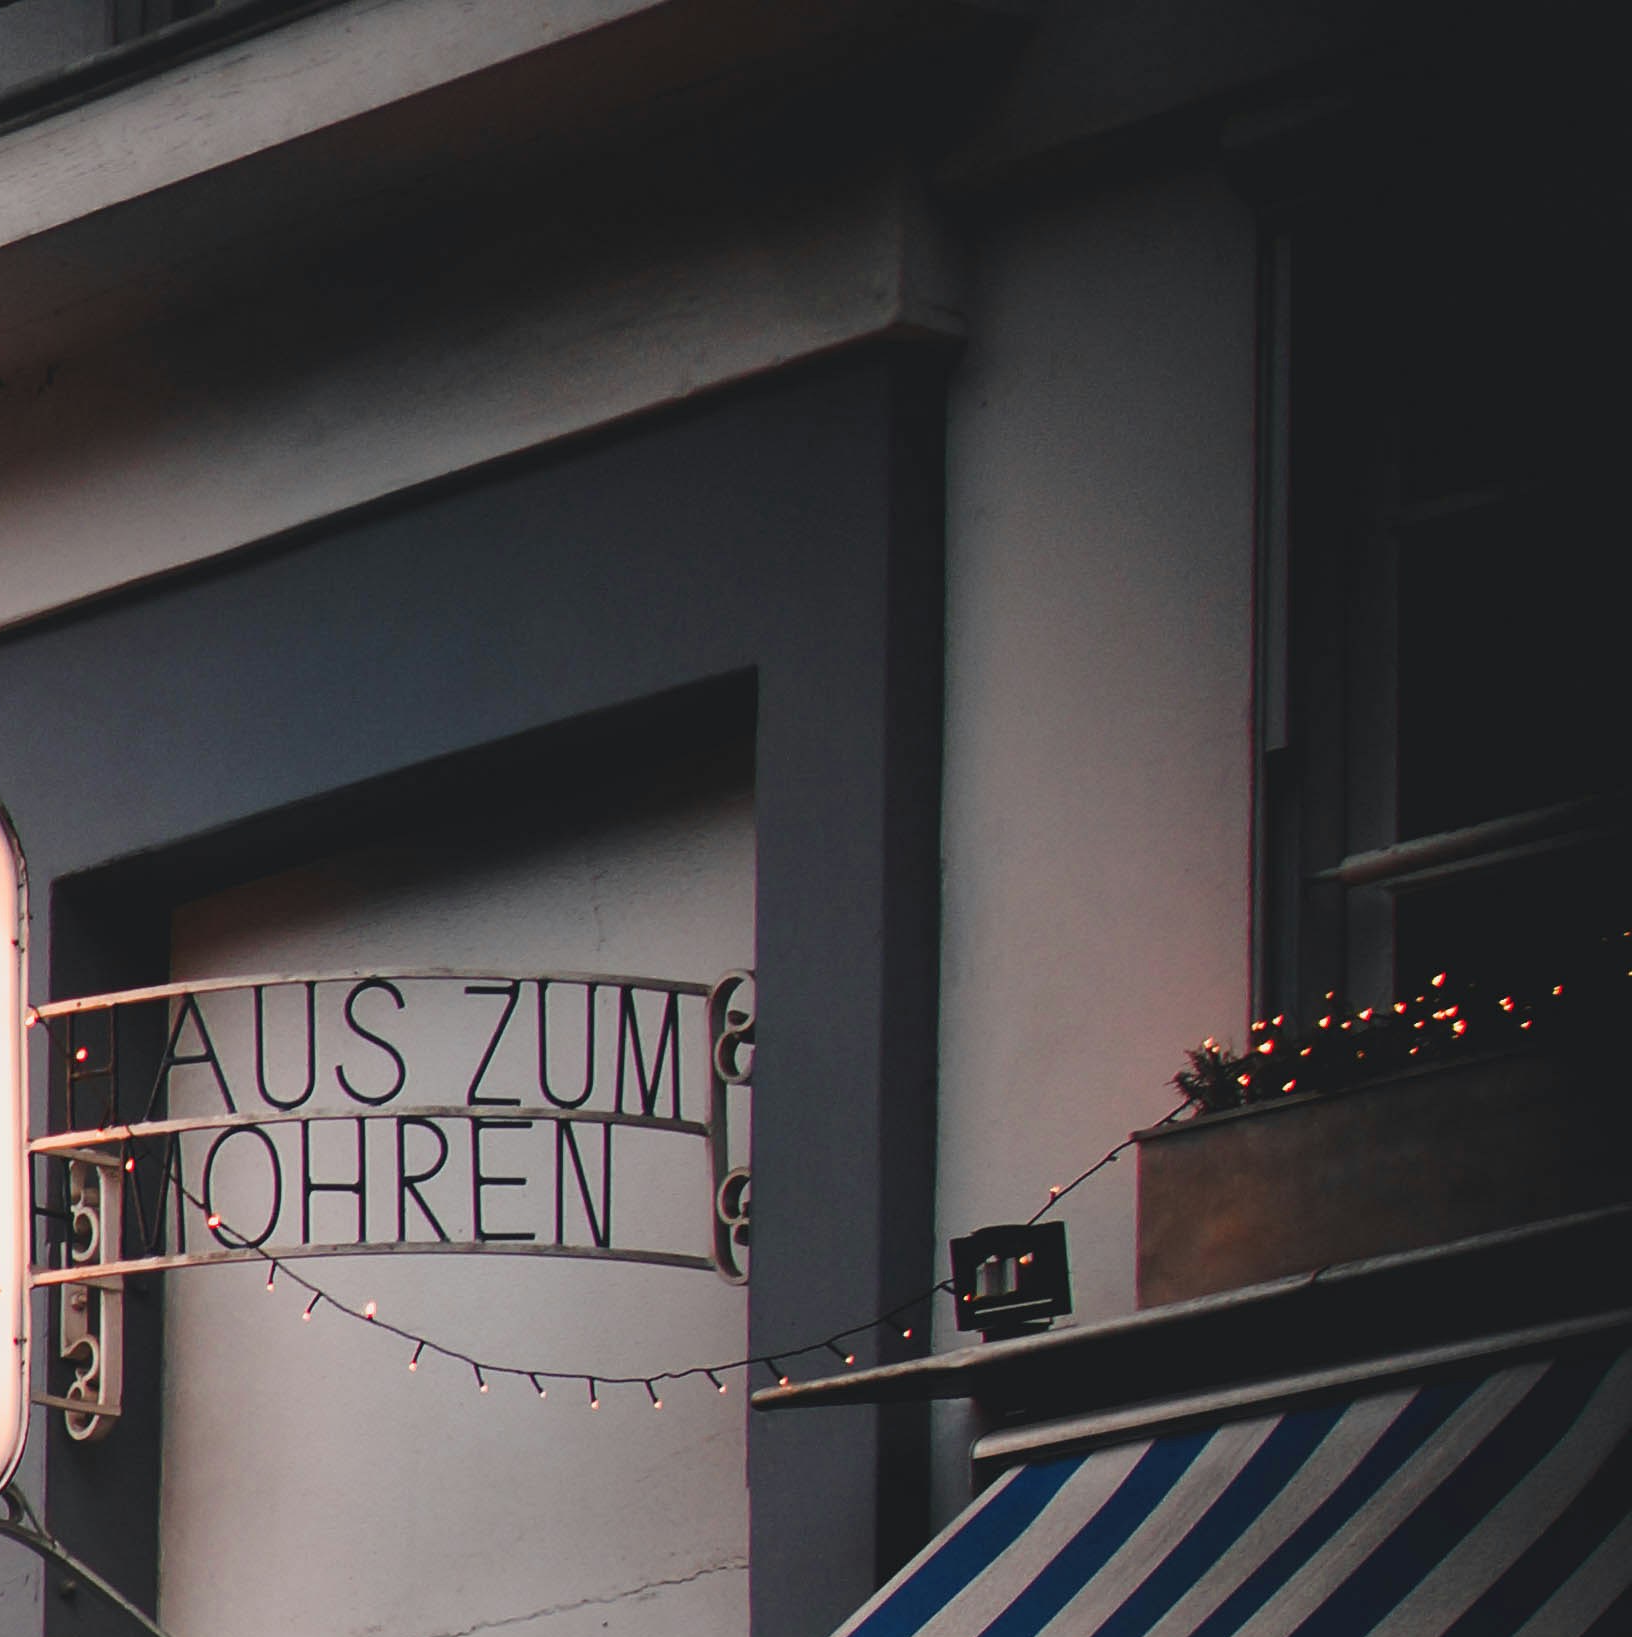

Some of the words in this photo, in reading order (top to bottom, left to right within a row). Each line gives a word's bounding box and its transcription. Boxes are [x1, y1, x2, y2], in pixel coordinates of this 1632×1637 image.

[67, 977, 407, 1130] HAUS
[463, 978, 682, 1121] ZUM
[120, 1115, 613, 1256] MOHREN
